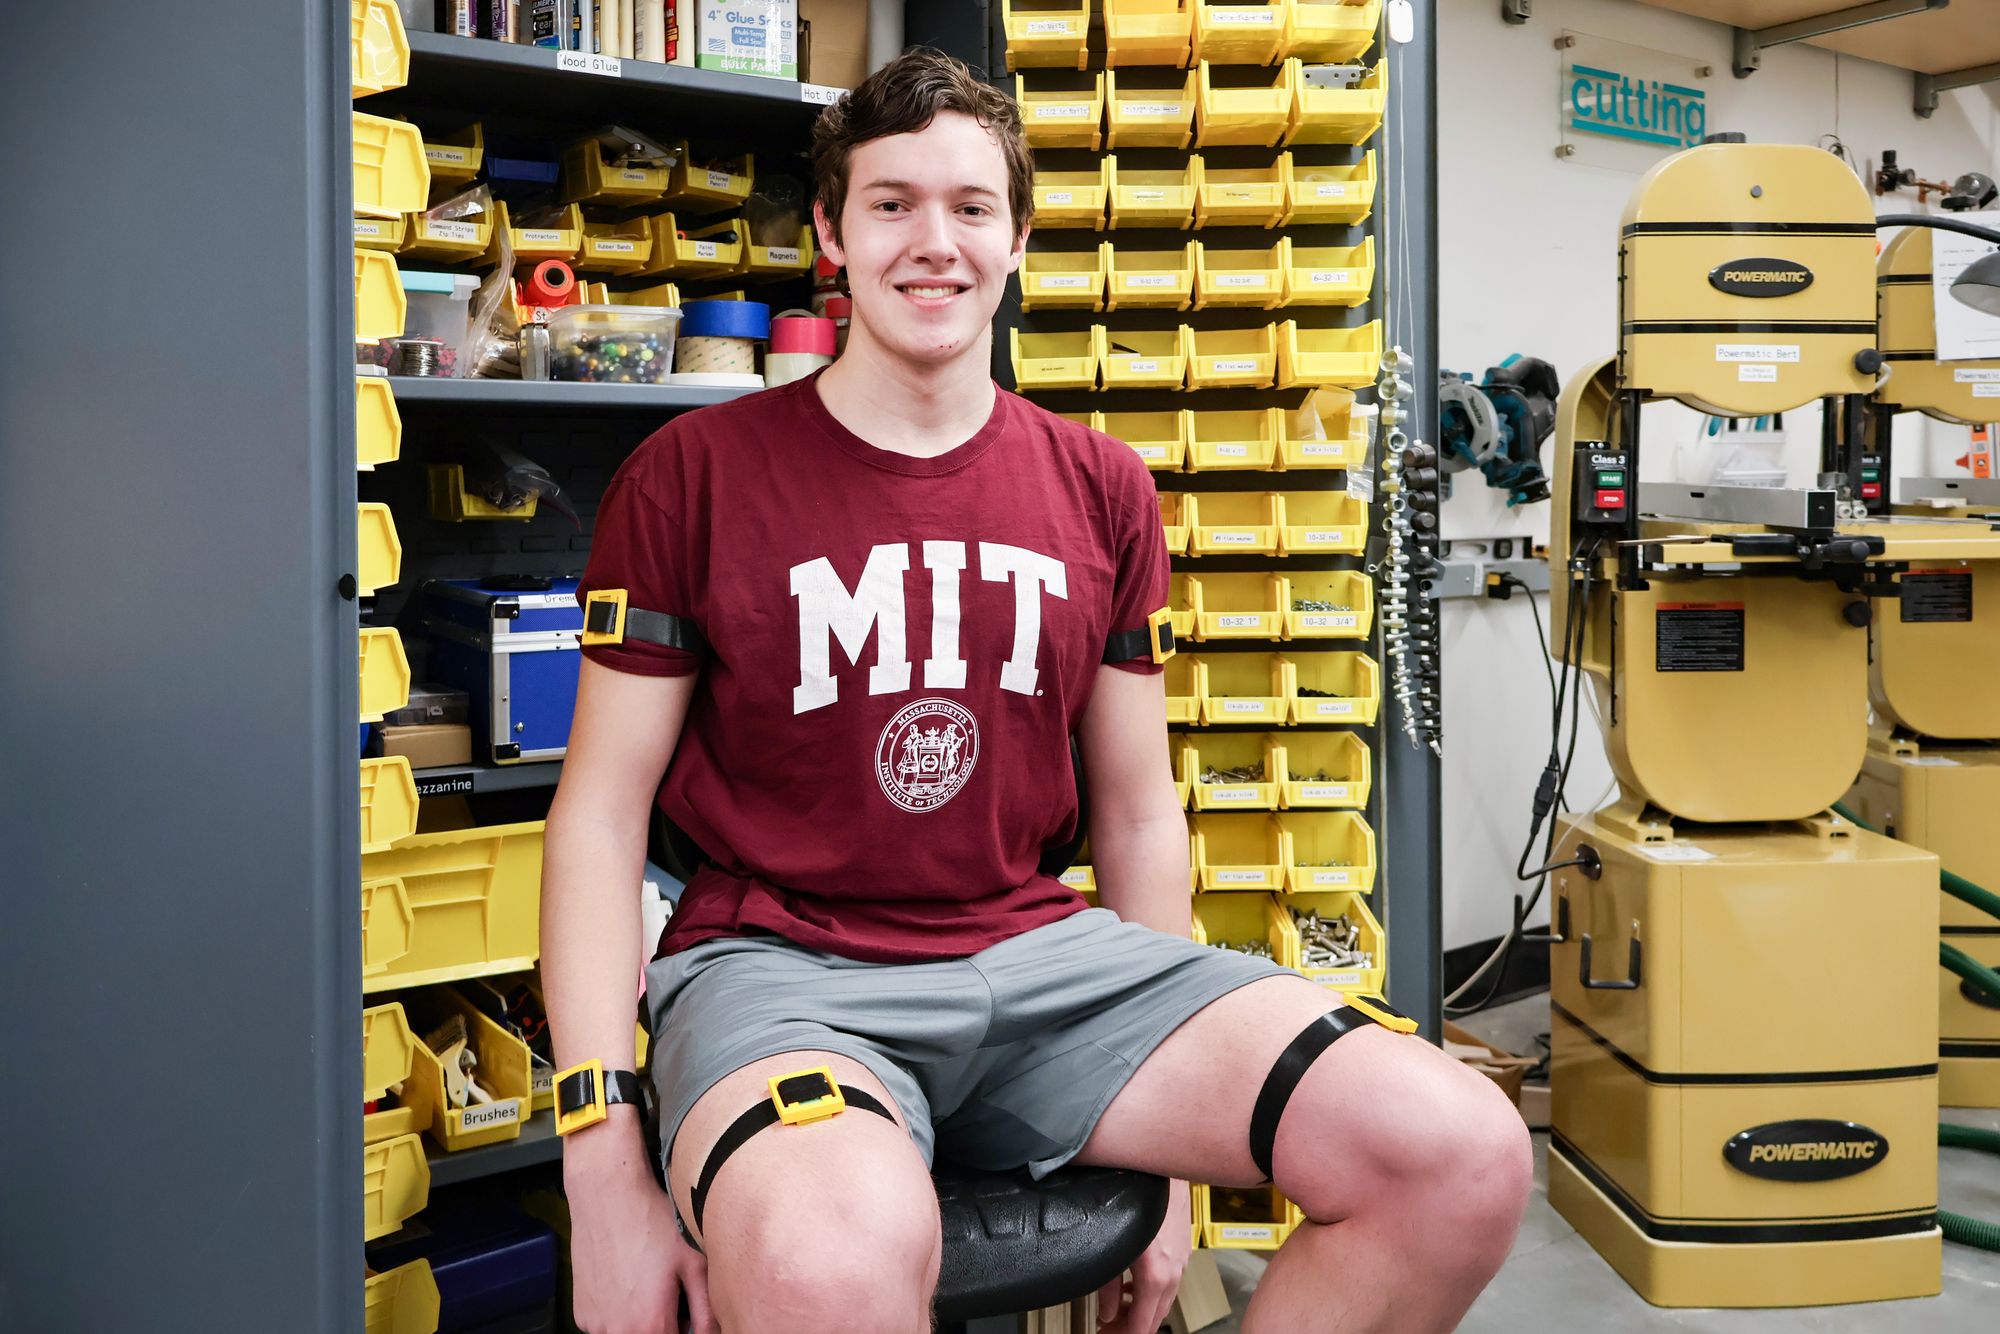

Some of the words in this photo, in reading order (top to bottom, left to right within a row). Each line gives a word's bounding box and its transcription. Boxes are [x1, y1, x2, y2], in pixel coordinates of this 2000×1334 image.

[726, 12, 755, 24] Glue
[593, 58, 618, 72] Glue
[804, 88, 820, 100] Hot
[1571, 76, 1705, 148] cutting
[769, 251, 798, 261] Magnets
[1724, 271, 1805, 283] POWERMATIC
[1718, 348, 1771, 358] Powermatic
[1777, 349, 1797, 359] Bert
[1591, 454, 1617, 464] Class
[1618, 455, 1626, 464] 3
[790, 540, 1068, 715] MIT
[1306, 617, 1327, 626] 10-32
[896, 704, 968, 727] MASSACHUSETTS
[416, 779, 472, 795] ezzanine
[881, 762, 912, 805] INSTITUTE
[926, 756, 972, 806] TECHNOLOGY
[464, 1108, 516, 1125] Brushes
[1749, 1142, 1876, 1162] POWERMATIC
